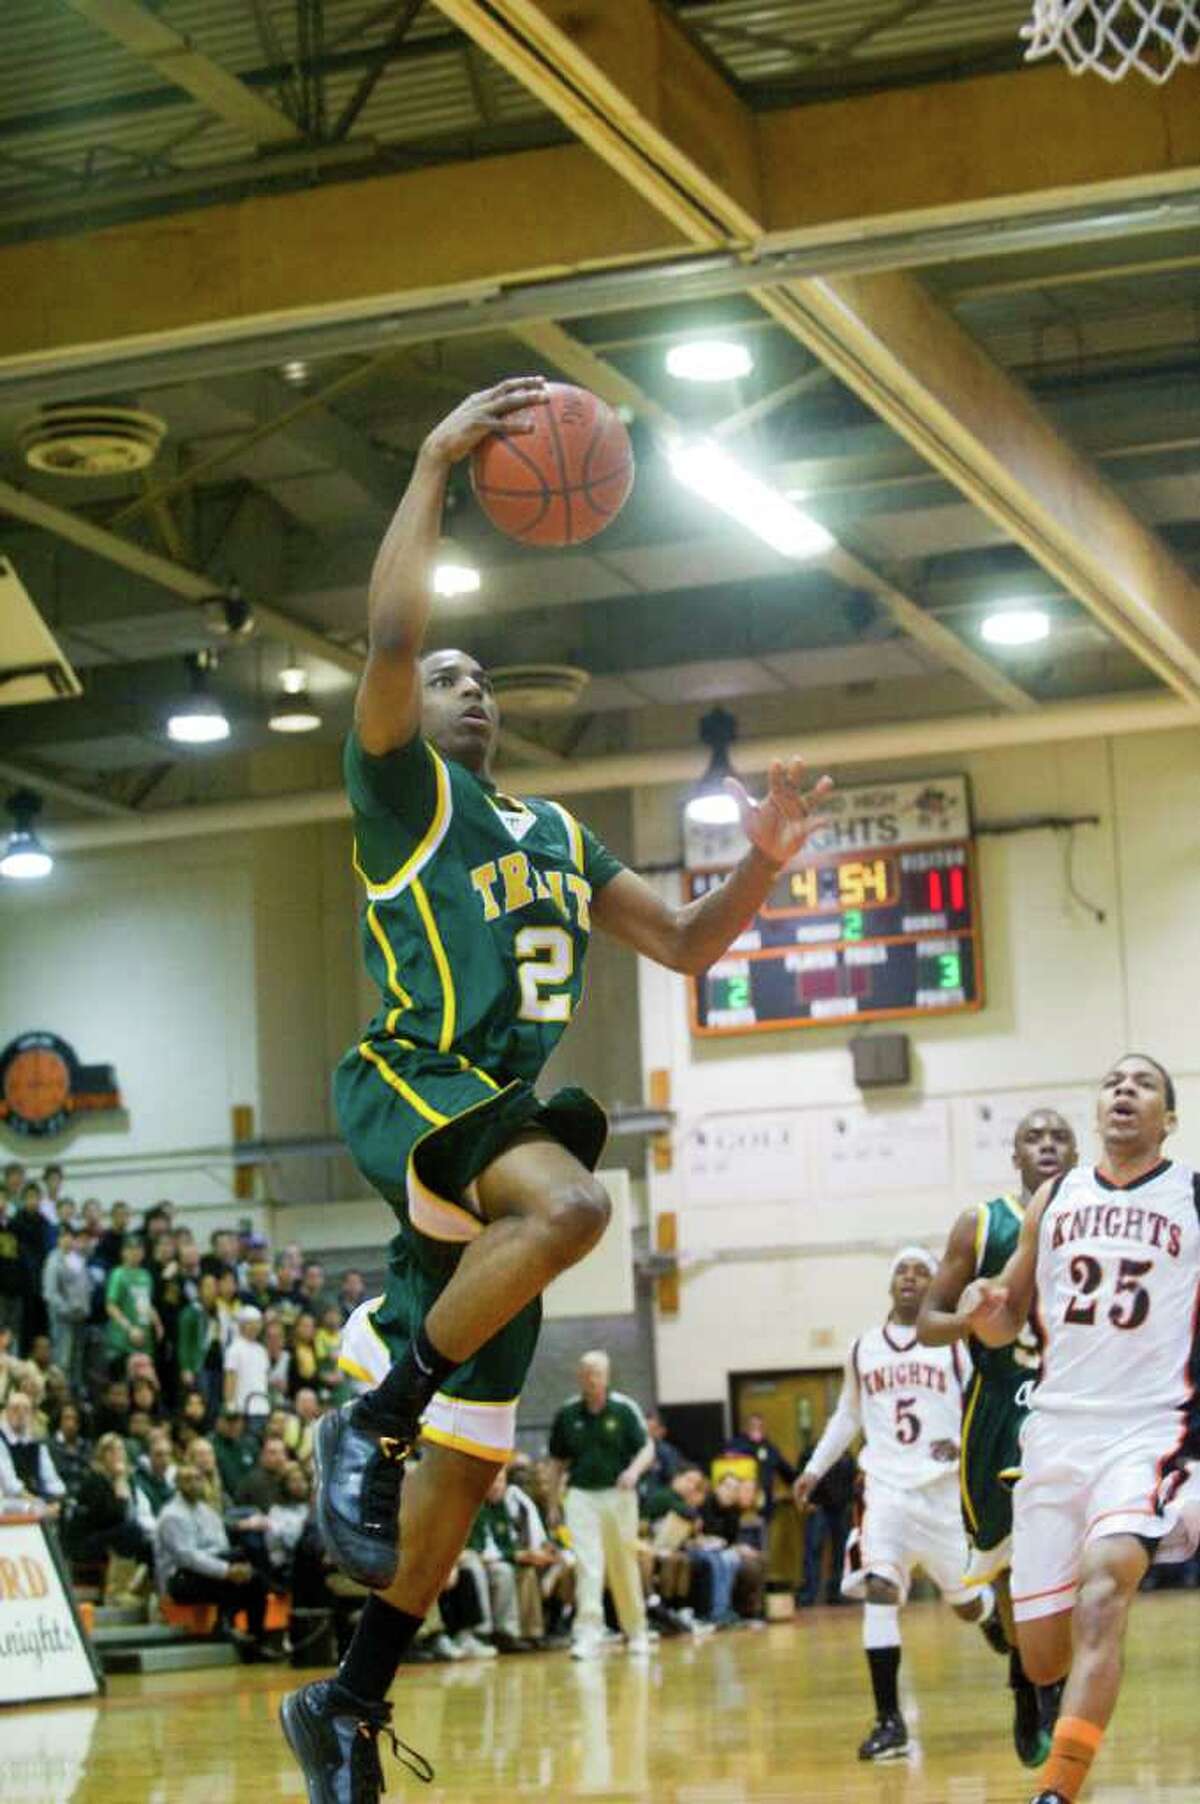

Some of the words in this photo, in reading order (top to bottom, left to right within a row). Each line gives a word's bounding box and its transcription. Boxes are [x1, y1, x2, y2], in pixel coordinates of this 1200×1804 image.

[811, 814, 899, 849] GHTS
[928, 868, 964, 911] 11
[842, 908, 864, 940] 2
[514, 925, 574, 1021] 2
[727, 976, 748, 1008] 2
[938, 955, 961, 988] 3
[1052, 1204, 1182, 1258] KNIGHTS
[1064, 1254, 1153, 1329] 25
[861, 1362, 947, 1395] KNIGHTS
[896, 1397, 921, 1445] 5
[0, 1613, 72, 1667] nights
